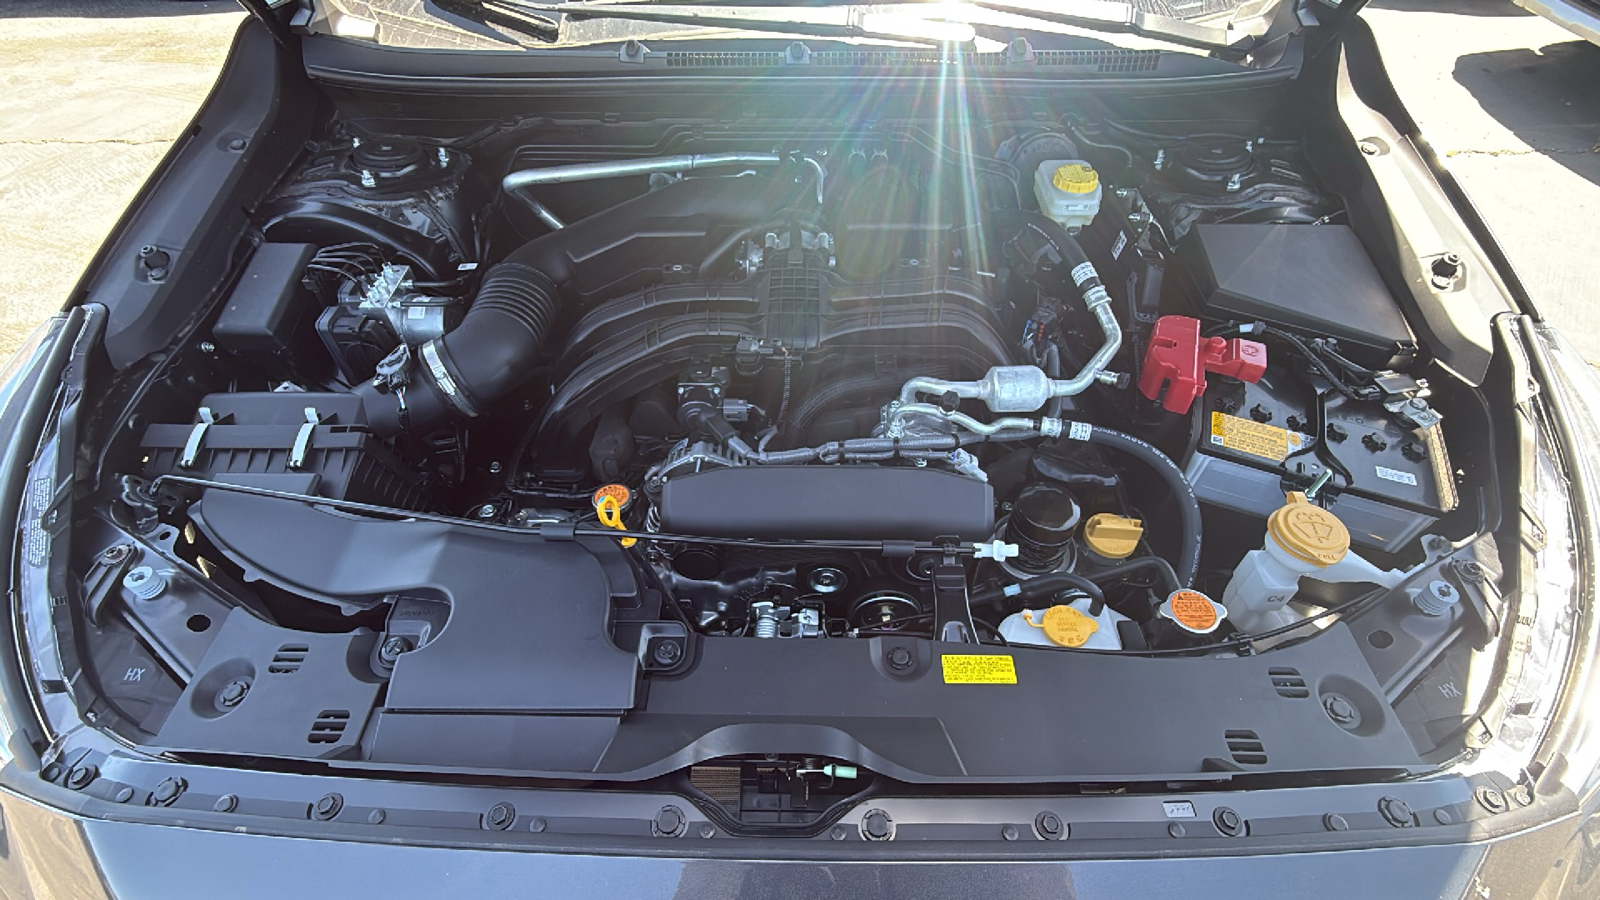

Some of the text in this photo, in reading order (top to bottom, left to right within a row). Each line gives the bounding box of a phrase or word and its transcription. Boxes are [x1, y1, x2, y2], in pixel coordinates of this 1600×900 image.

[1267, 595, 1286, 603] C4
[123, 667, 146, 681] HX
[1438, 681, 1462, 699] HX
